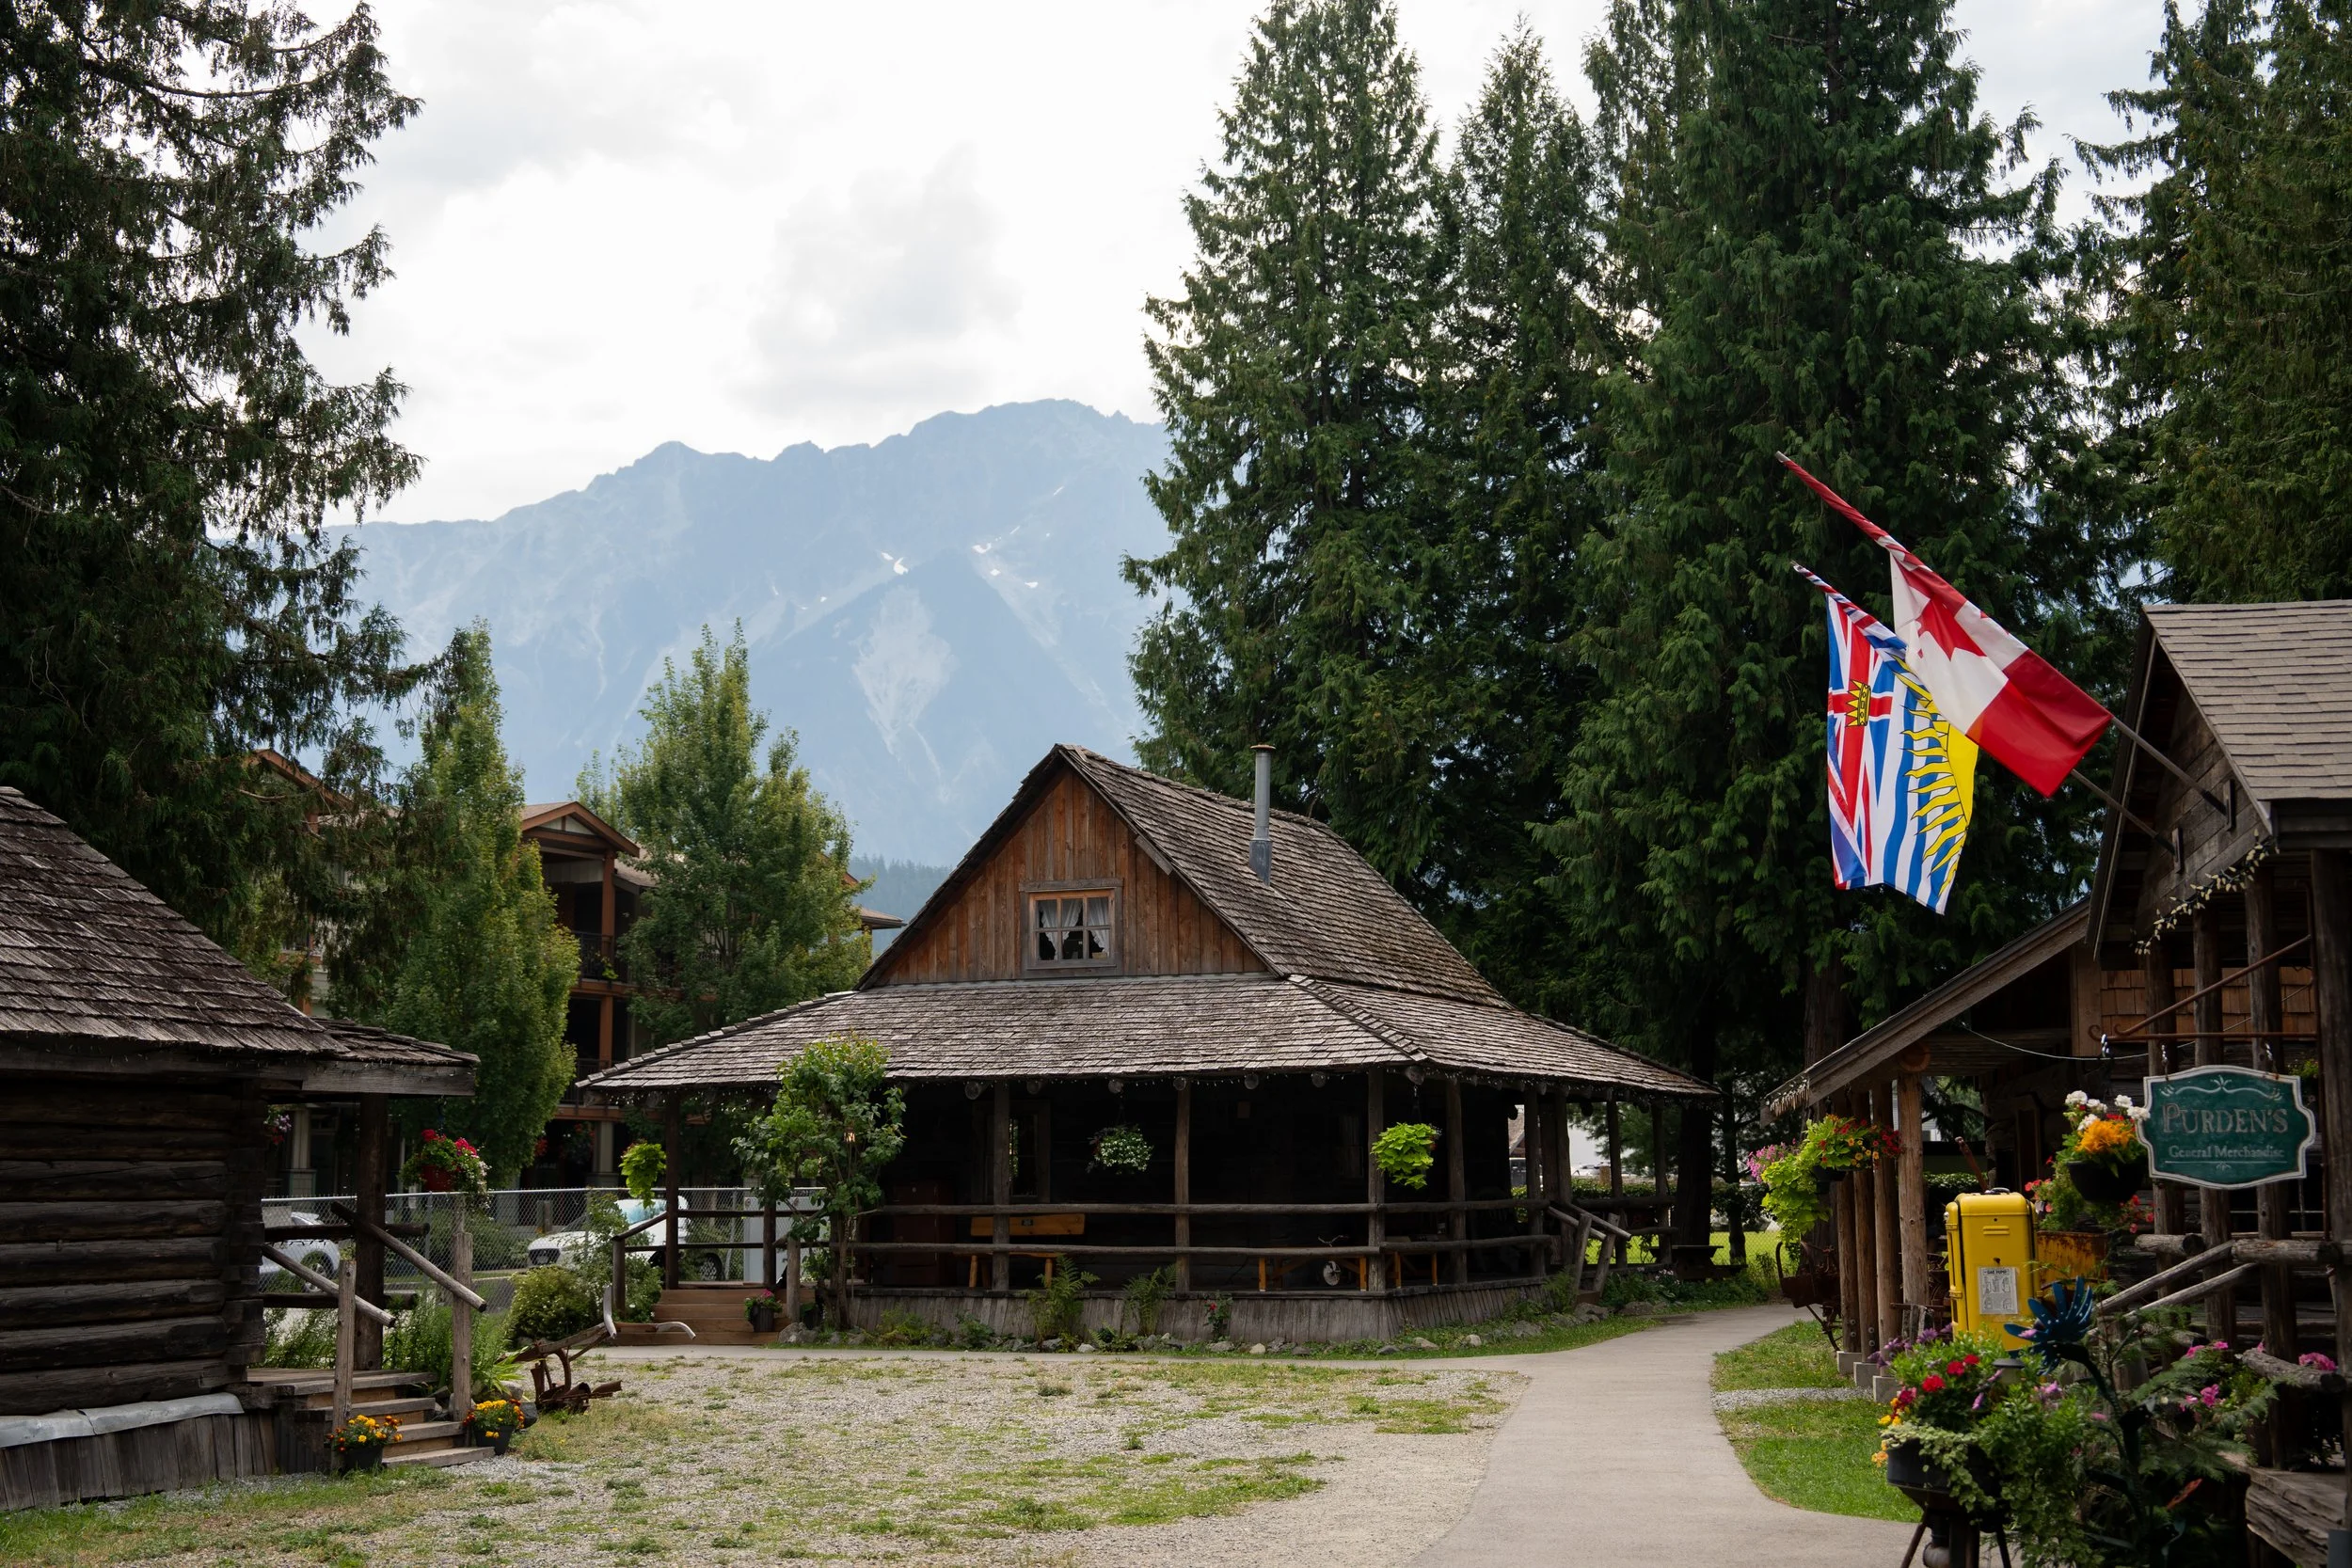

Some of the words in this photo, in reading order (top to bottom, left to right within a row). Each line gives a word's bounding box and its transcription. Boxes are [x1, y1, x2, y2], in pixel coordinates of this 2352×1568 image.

[2162, 1103, 2288, 1133] PURDEN'S
[2169, 1145, 2211, 1158] General
[2215, 1145, 2285, 1158] Merchandise
